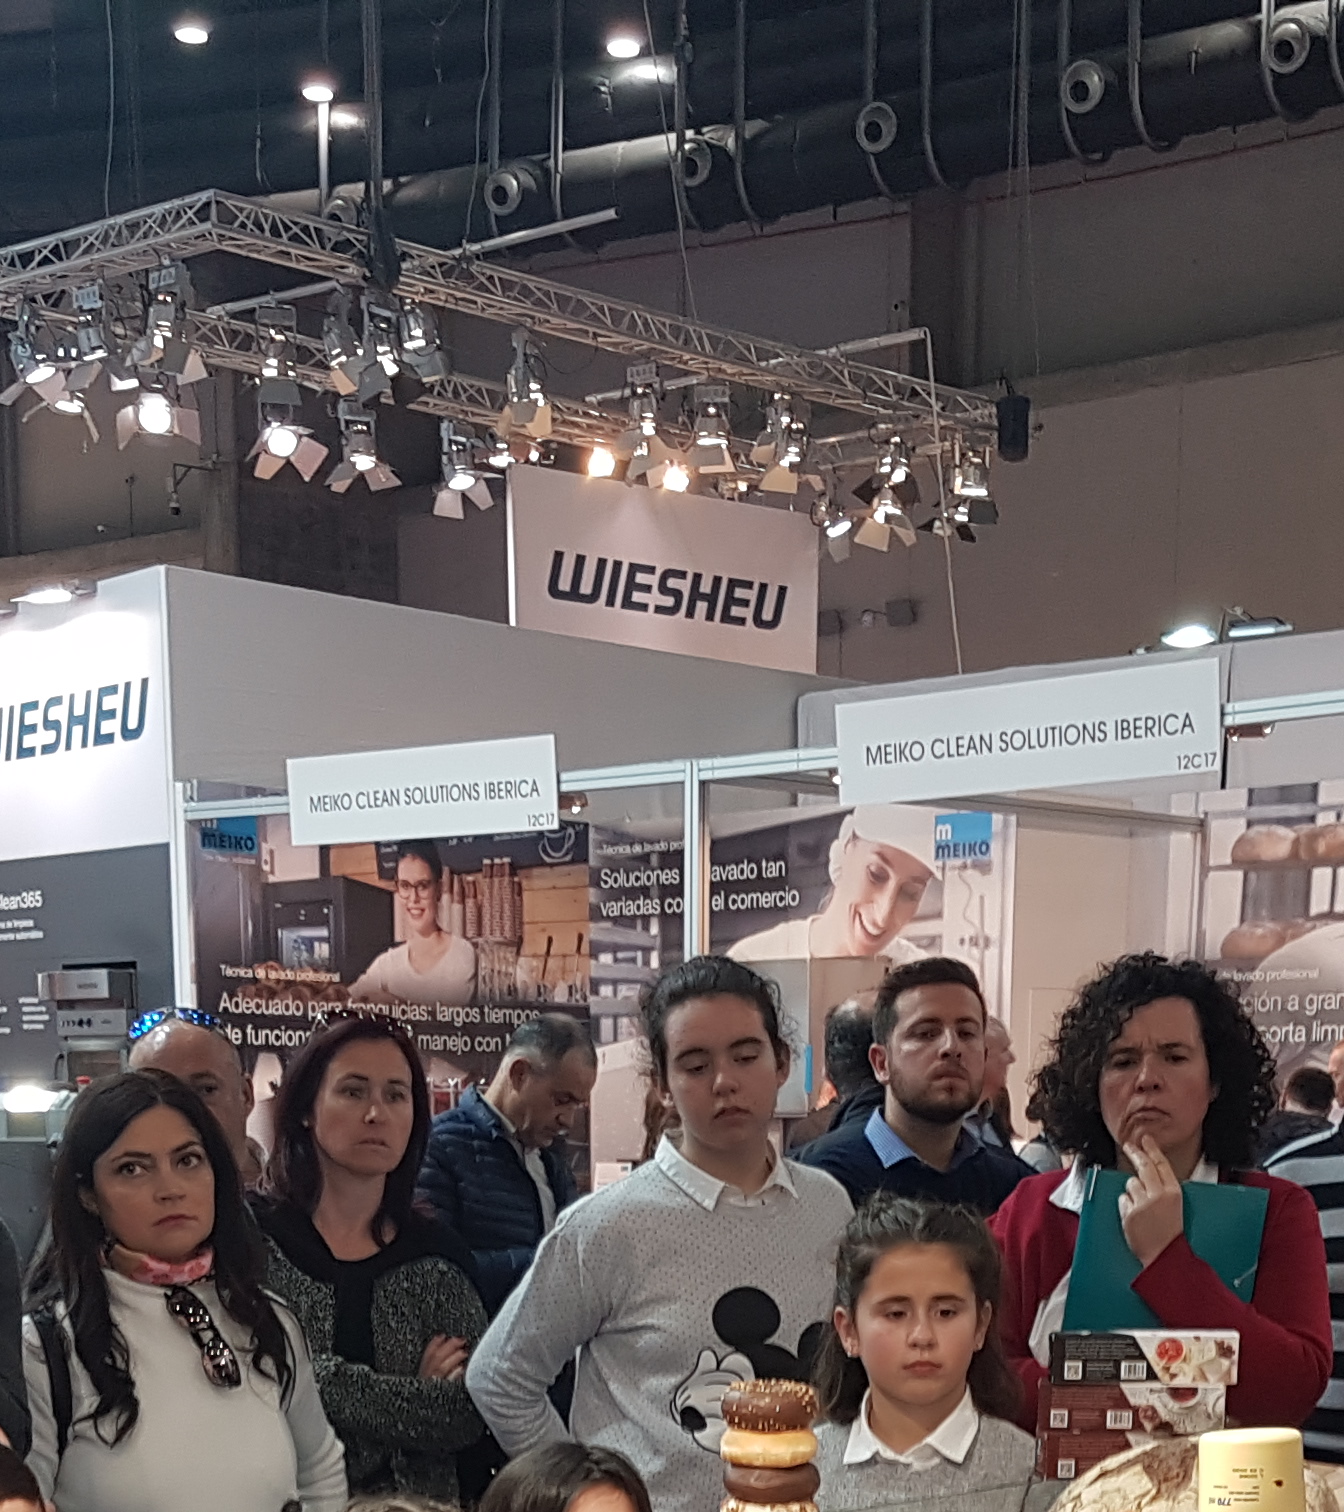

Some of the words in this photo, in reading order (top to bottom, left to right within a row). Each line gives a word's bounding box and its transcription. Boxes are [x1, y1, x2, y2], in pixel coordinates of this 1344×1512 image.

[548, 549, 788, 631] WIESHEU
[865, 740, 925, 767] MEIKO
[931, 733, 993, 760] CLEAN
[998, 721, 1108, 753] SOLUTIONS
[1114, 712, 1196, 742] IBERICA
[1176, 752, 1218, 771] 12C17
[309, 793, 353, 814] MEIKO
[356, 788, 400, 810] CLEAN
[404, 782, 481, 807] SOLUTIONS
[484, 778, 541, 801] IBERICA
[527, 813, 556, 827] 12C17
[600, 866, 680, 889] Soluciones
[711, 858, 757, 881] avado
[761, 857, 786, 878] tan
[600, 895, 661, 917] variadas
[664, 897, 684, 914] co
[711, 890, 725, 911] el
[728, 885, 800, 911] comercio
[220, 964, 253, 979] Técnica
[1266, 968, 1320, 983] profesional
[219, 992, 304, 1017] Adecuado
[436, 1000, 480, 1026] largos
[484, 1003, 541, 1029] tiempos
[1287, 995, 1299, 1012] a
[418, 1032, 472, 1055] manejo
[475, 1035, 503, 1052] con
